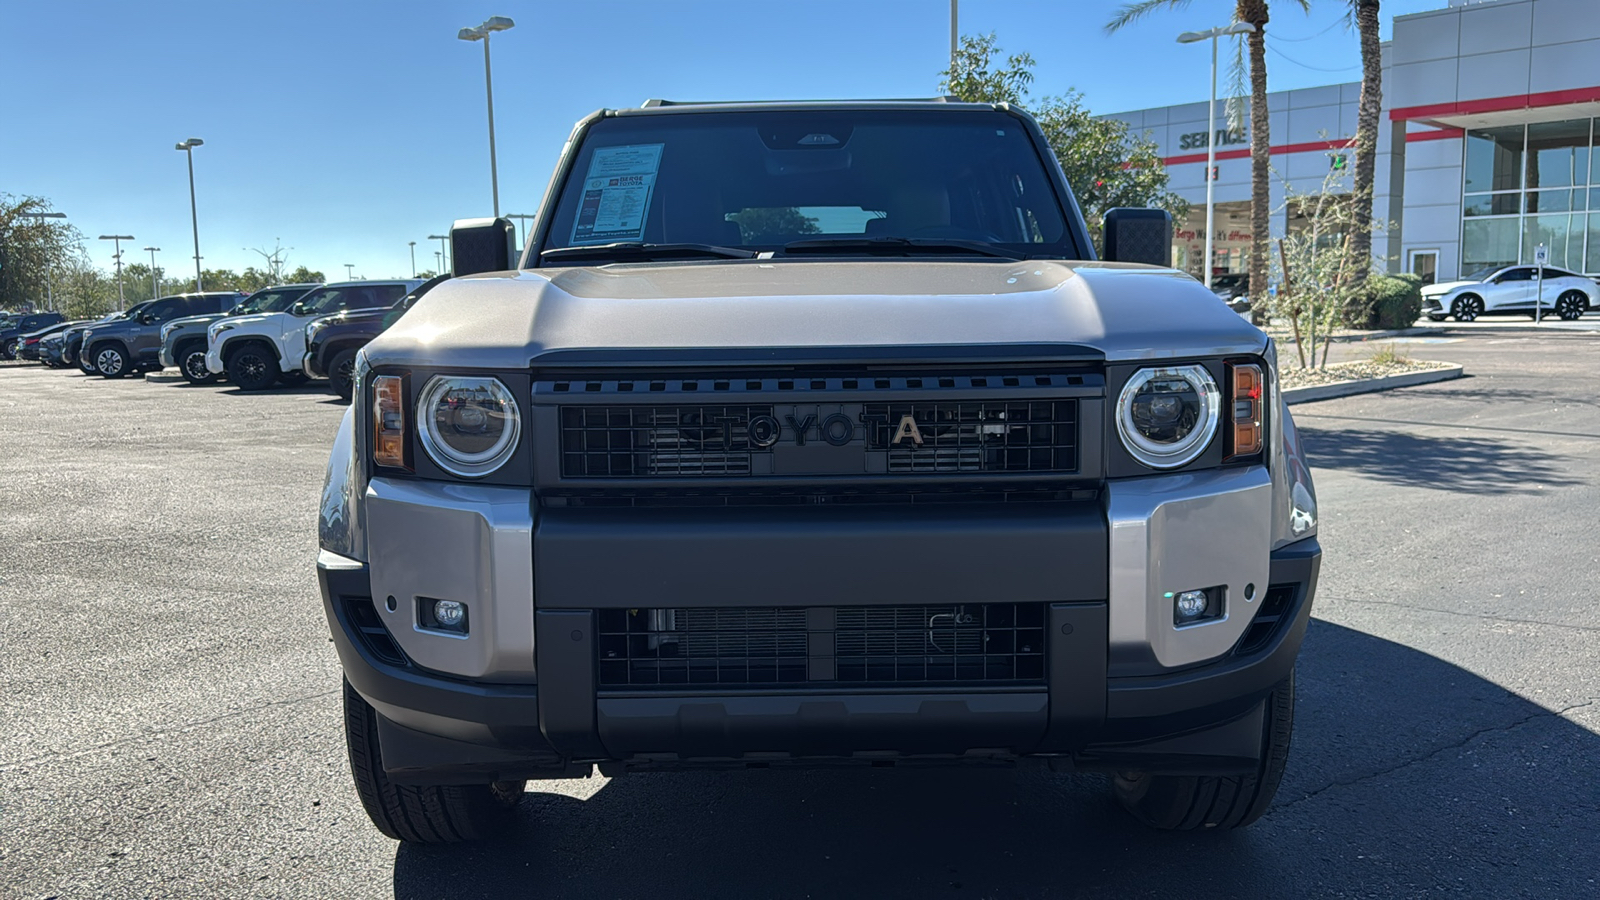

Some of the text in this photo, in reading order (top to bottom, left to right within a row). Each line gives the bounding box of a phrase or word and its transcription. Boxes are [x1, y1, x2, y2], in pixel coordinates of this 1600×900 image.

[1176, 228, 1195, 242] Berge
[1228, 230, 1252, 241] differen
[714, 412, 924, 448] TOYOTA
